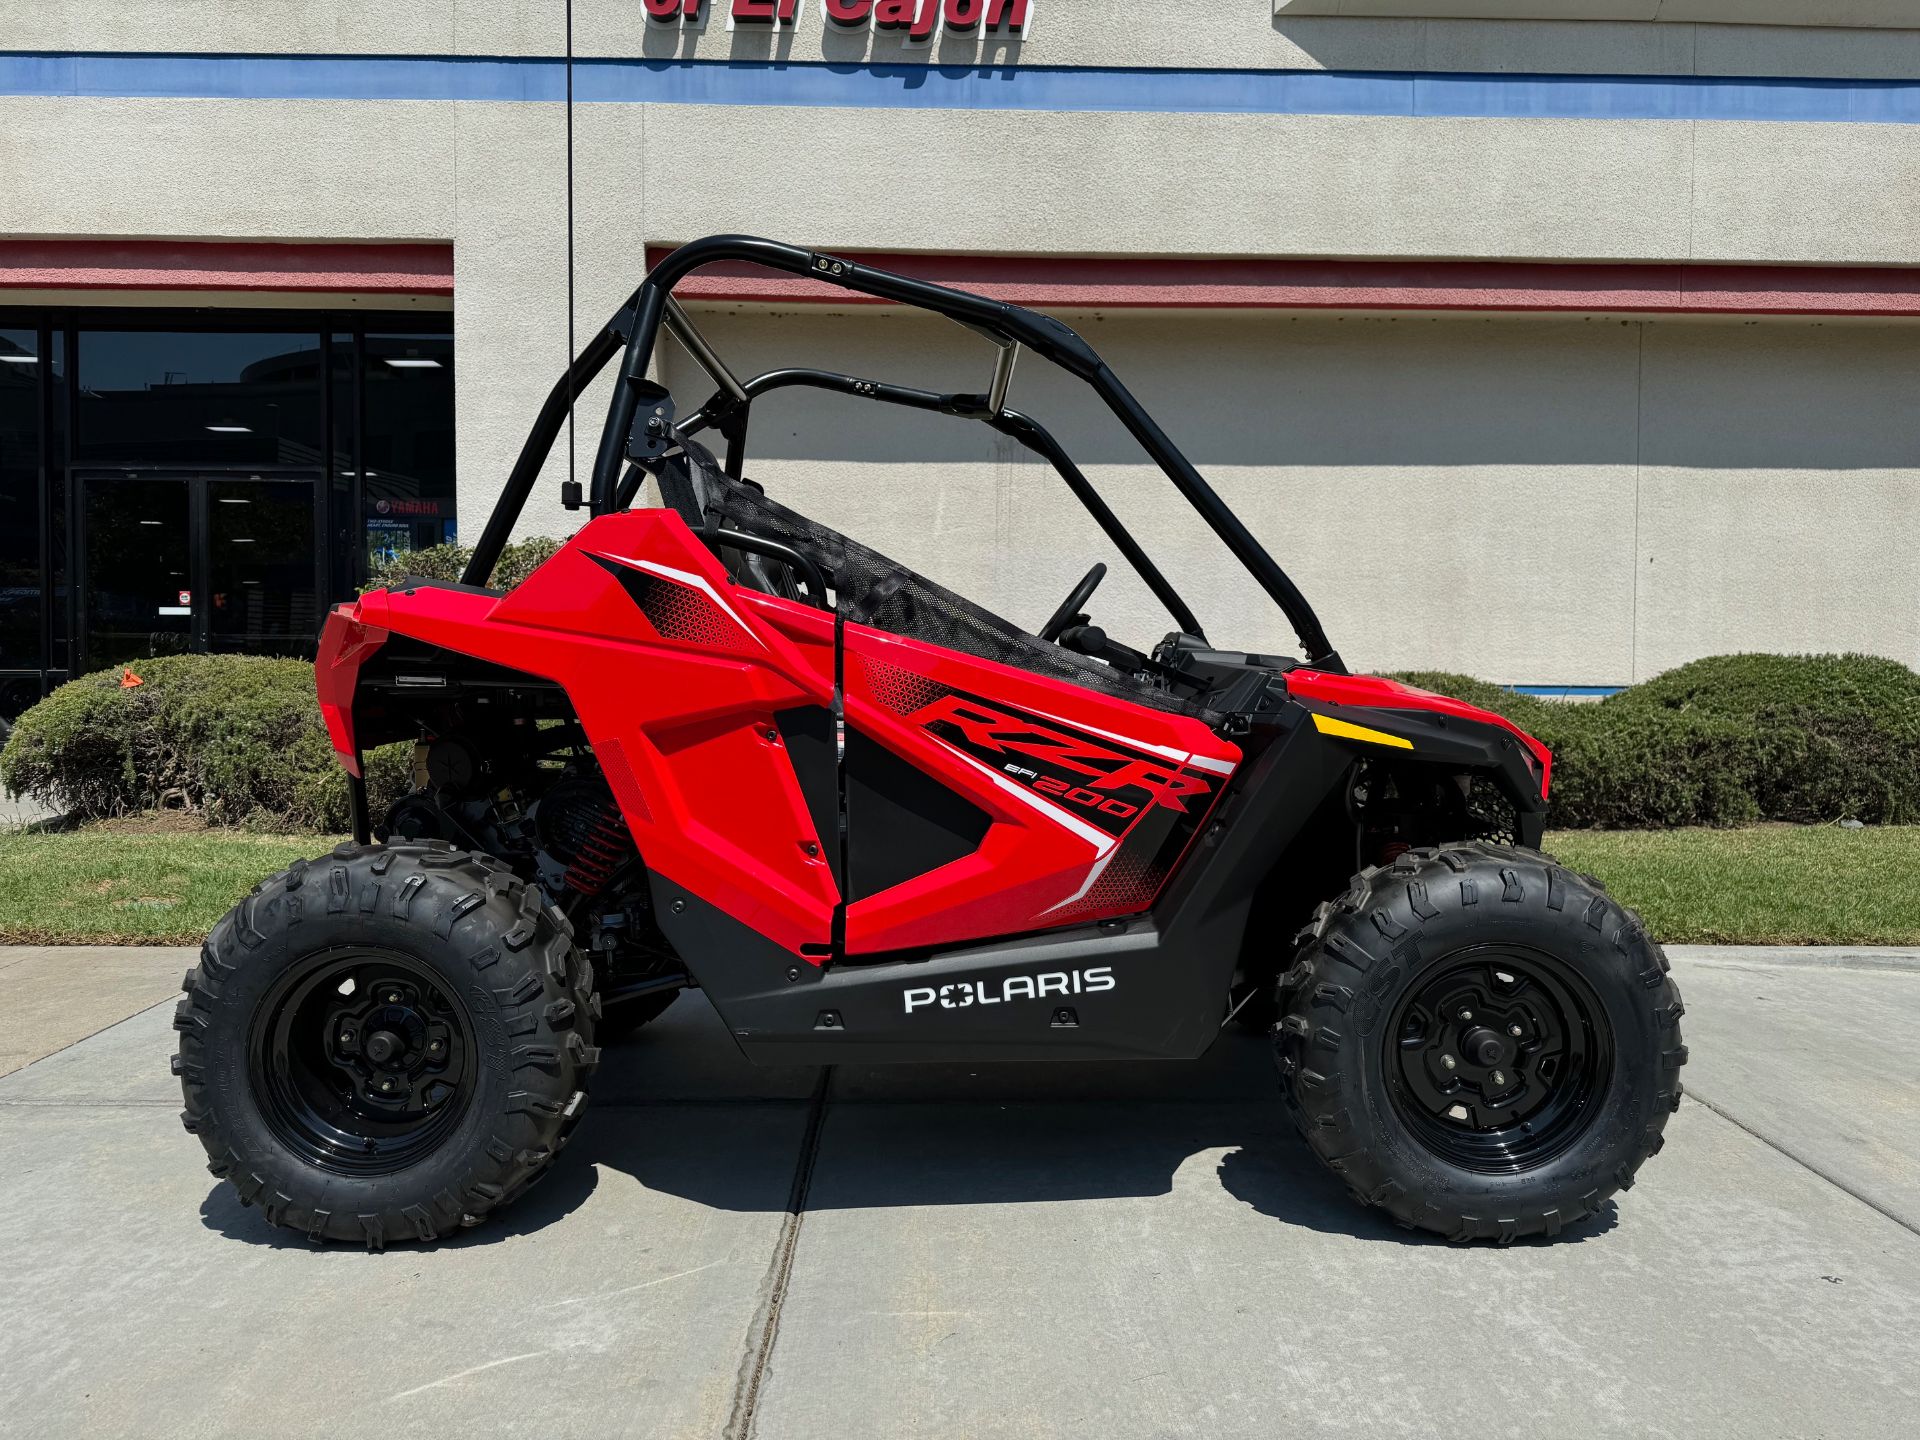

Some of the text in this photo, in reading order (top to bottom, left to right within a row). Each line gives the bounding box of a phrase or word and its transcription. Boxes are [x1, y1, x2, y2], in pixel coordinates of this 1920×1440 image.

[391, 501, 439, 514] YAMAHA
[1003, 763, 1139, 818] EFI 200
[903, 966, 1116, 1014] POLARIS
